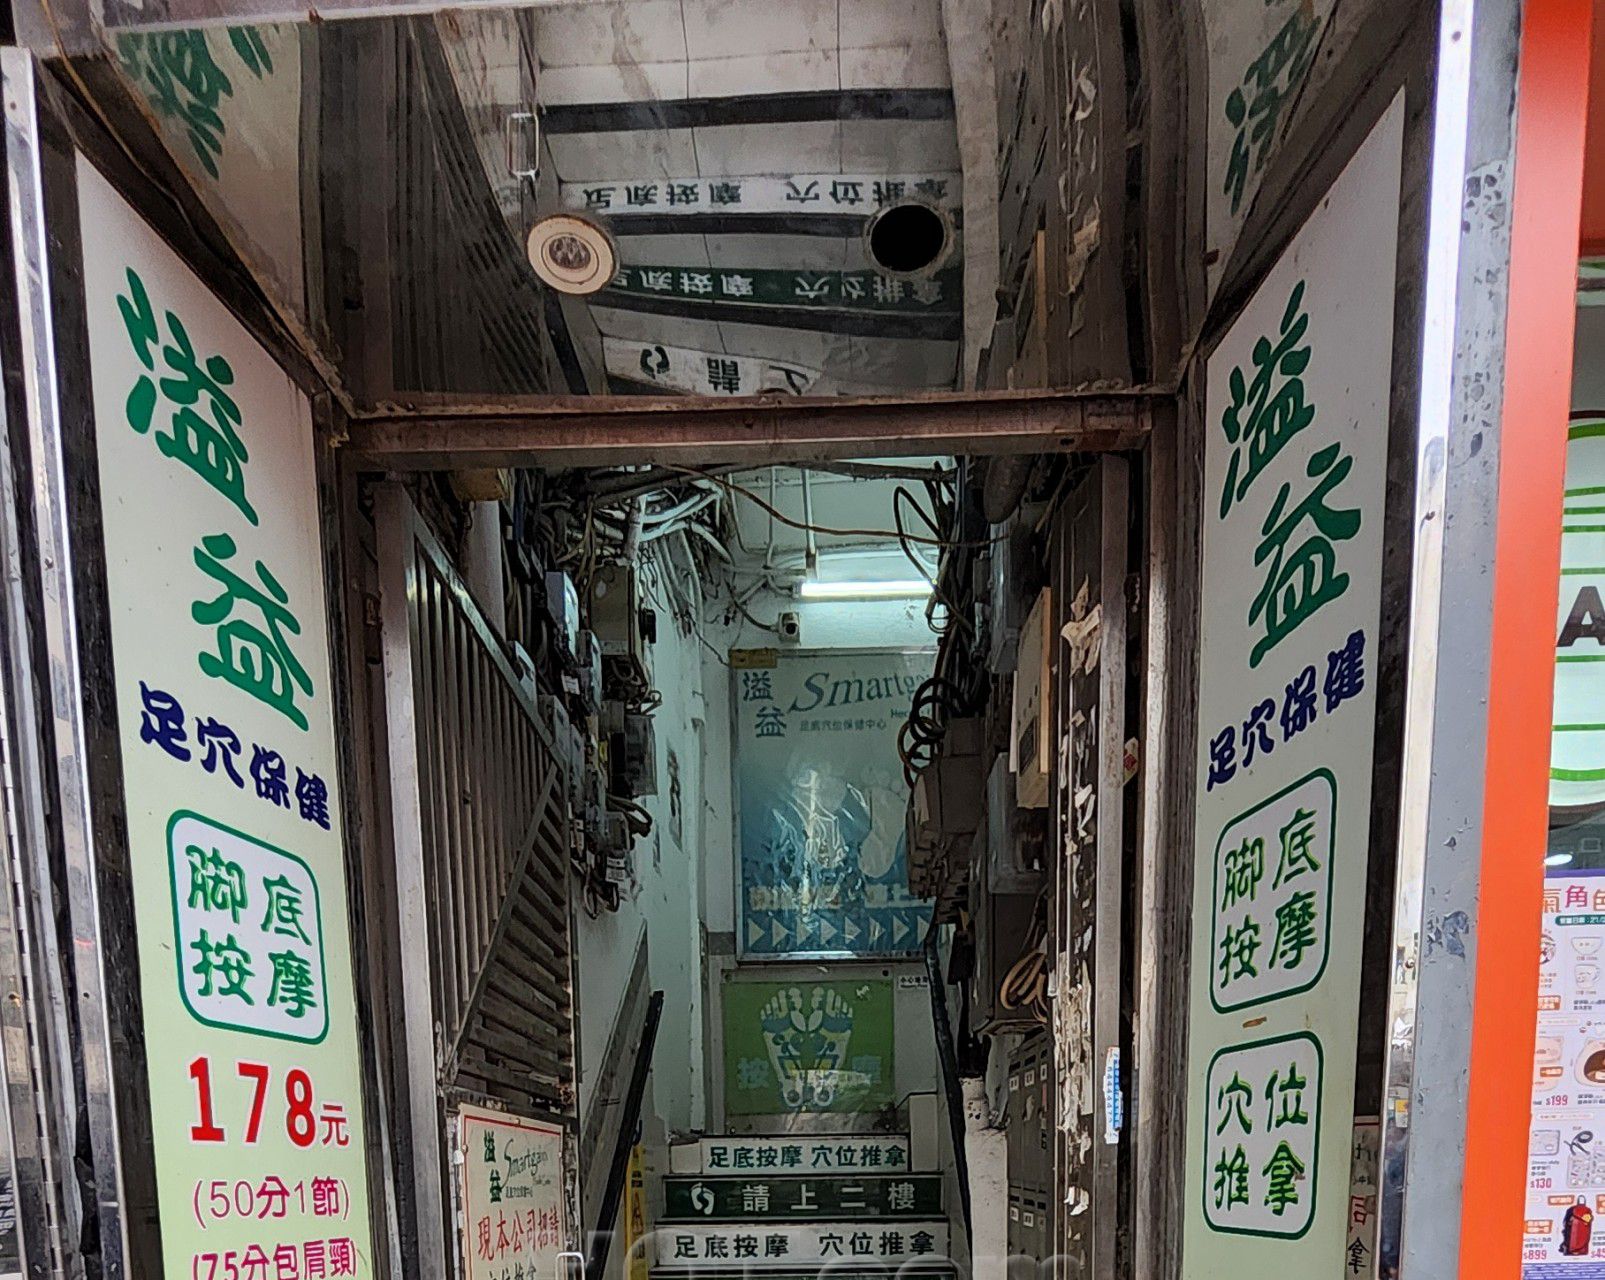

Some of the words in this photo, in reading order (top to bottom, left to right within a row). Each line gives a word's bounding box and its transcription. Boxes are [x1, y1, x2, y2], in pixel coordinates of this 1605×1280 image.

[116, 266, 315, 732] 溢益
[1219, 279, 1363, 668] 溢益
[1206, 629, 1366, 792] 足穴保健
[139, 681, 332, 831] 足穴保健
[1216, 1062, 1309, 1137] 穴位
[708, 1146, 803, 1168] 足底按摩
[811, 1145, 906, 1167] 穴位推拿
[1213, 1140, 1306, 1217] 推拿
[742, 1182, 916, 1212] 請上二樓
[674, 1234, 789, 1259] 足底按摩
[819, 1231, 935, 1256] 穴位推拿
